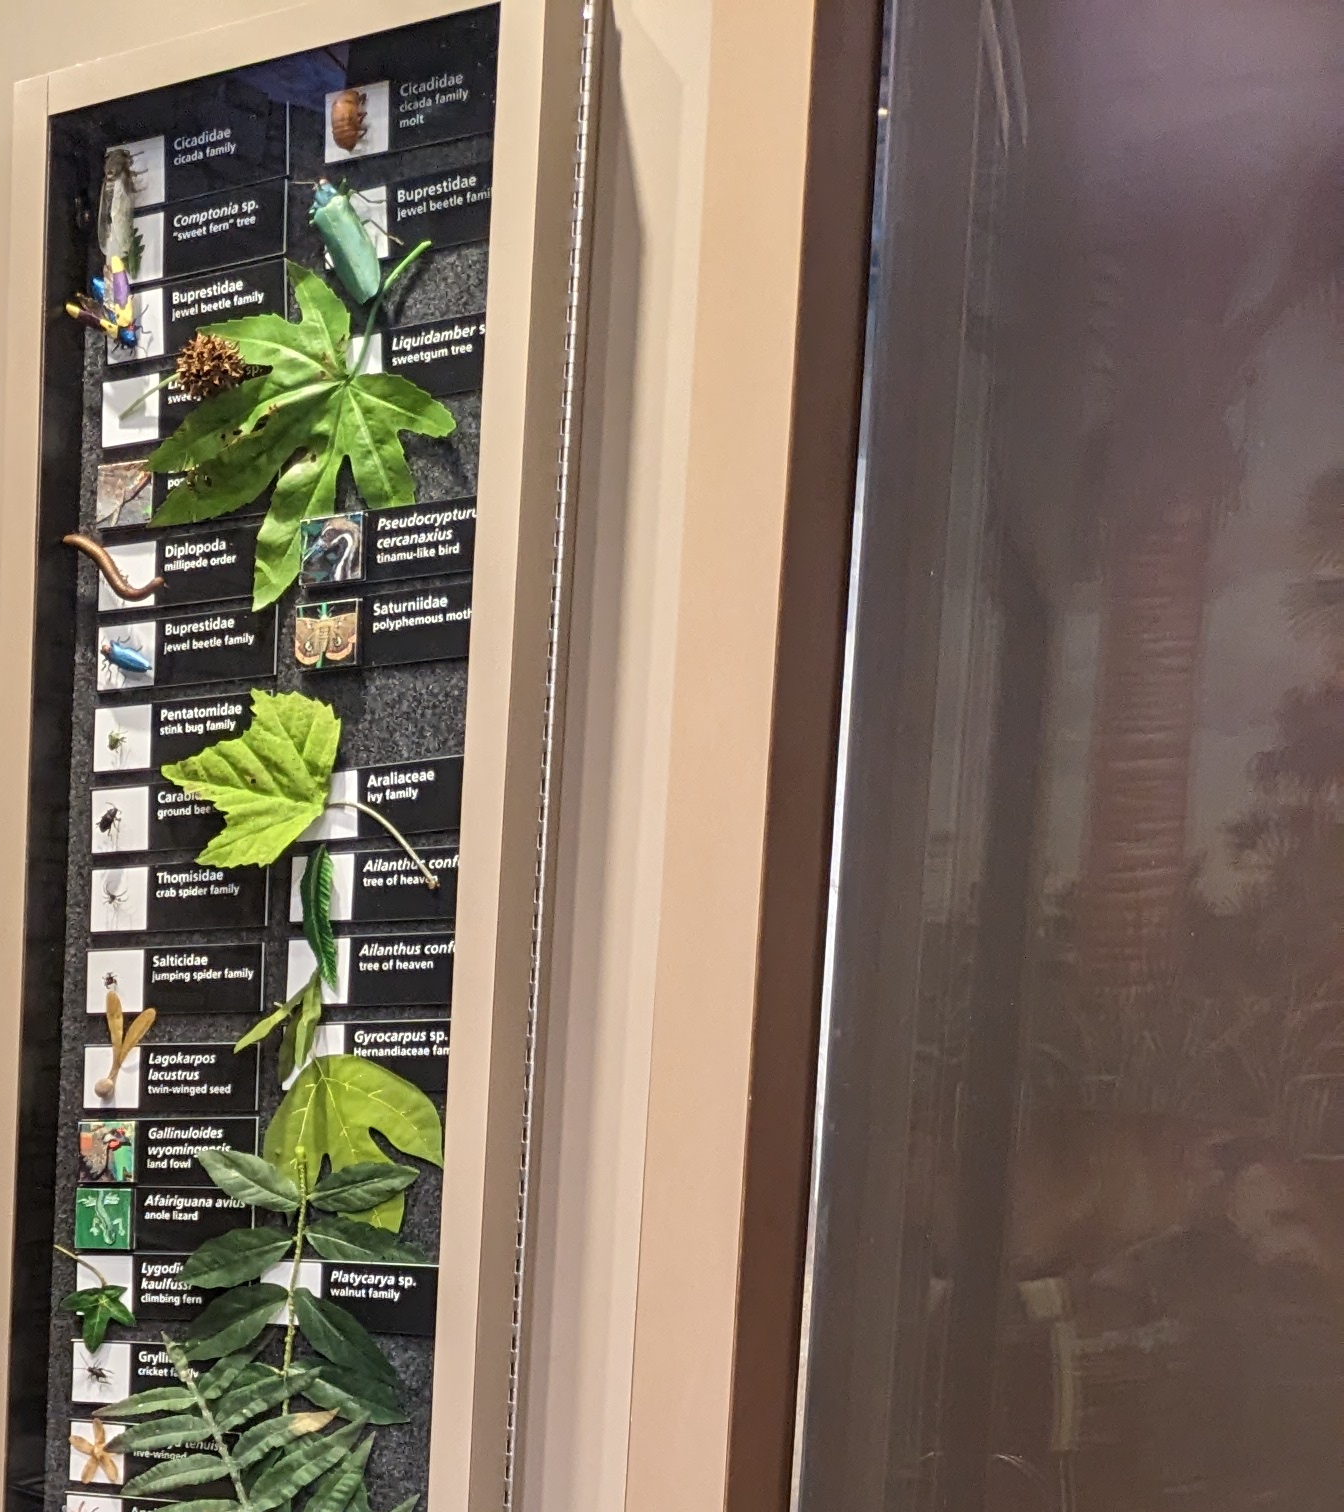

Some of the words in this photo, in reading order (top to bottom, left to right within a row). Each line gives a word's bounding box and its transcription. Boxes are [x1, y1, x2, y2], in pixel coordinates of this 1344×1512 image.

[435, 88, 469, 104] family
[399, 115, 424, 128] molt
[174, 127, 231, 150] Cicadidae
[174, 150, 203, 166] cicada
[206, 142, 236, 158] family
[397, 175, 477, 203] Buprestidae
[173, 202, 239, 227] Comptonia
[242, 200, 259, 214] sp.
[397, 203, 427, 221] jewel
[430, 195, 463, 211] beetle
[237, 215, 256, 228] tree
[172, 279, 244, 304] Buprestidae
[172, 304, 198, 320] jewel
[201, 296, 231, 313] beetle
[233, 291, 264, 307] family
[392, 324, 476, 352] Liquidamber
[392, 349, 448, 366] sweetgum
[451, 343, 473, 354] tree
[377, 528, 453, 549] cercanaxius
[165, 538, 226, 559] Diplopoda
[438, 542, 460, 556] bird
[164, 557, 208, 572] millipede
[210, 554, 237, 566] order
[373, 595, 448, 616] Saturniidae
[165, 617, 235, 636] Buprestidae
[373, 613, 443, 633] polyphemous
[163, 640, 190, 655] jewel
[192, 636, 222, 650] beetle
[224, 633, 255, 645] family
[160, 703, 242, 721] Pentatomidae
[160, 722, 183, 735] stink
[185, 720, 204, 734] bug
[206, 719, 236, 732] family
[367, 769, 435, 788] Araliaceae
[367, 792, 383, 804] ivy
[386, 787, 419, 800] family
[157, 806, 191, 820] ground
[157, 871, 223, 885] Thomisidae
[363, 875, 383, 887] tree
[386, 874, 397, 885] of
[156, 887, 176, 898] crab
[179, 886, 207, 898] spider
[210, 884, 240, 897] family
[359, 942, 421, 957] Ailanthus
[152, 954, 208, 968] Salticidae
[359, 961, 379, 971] tree
[382, 960, 393, 970] of
[396, 960, 434, 970] heaven
[152, 970, 190, 983] jumping
[193, 970, 221, 982] spider
[224, 968, 254, 981] family
[354, 1030, 427, 1045] Gyrocarpus
[430, 1031, 448, 1044] sp.
[354, 1046, 430, 1057] Hernandiaceae
[149, 1052, 216, 1067] Lagokarpos
[148, 1069, 199, 1081] lacustrus
[209, 1084, 231, 1094] seed
[148, 1127, 223, 1139] Gallinuloides
[147, 1159, 167, 1169] land
[170, 1159, 191, 1169] fowl
[144, 1211, 170, 1220] anole
[173, 1211, 199, 1221] lizard
[331, 1270, 395, 1287] Platycarya
[398, 1275, 416, 1288] sp.
[141, 1294, 180, 1306] climbing
[182, 1294, 202, 1304] fern
[331, 1287, 366, 1298] walnut
[368, 1288, 400, 1302] family
[138, 1367, 168, 1377] cricket
